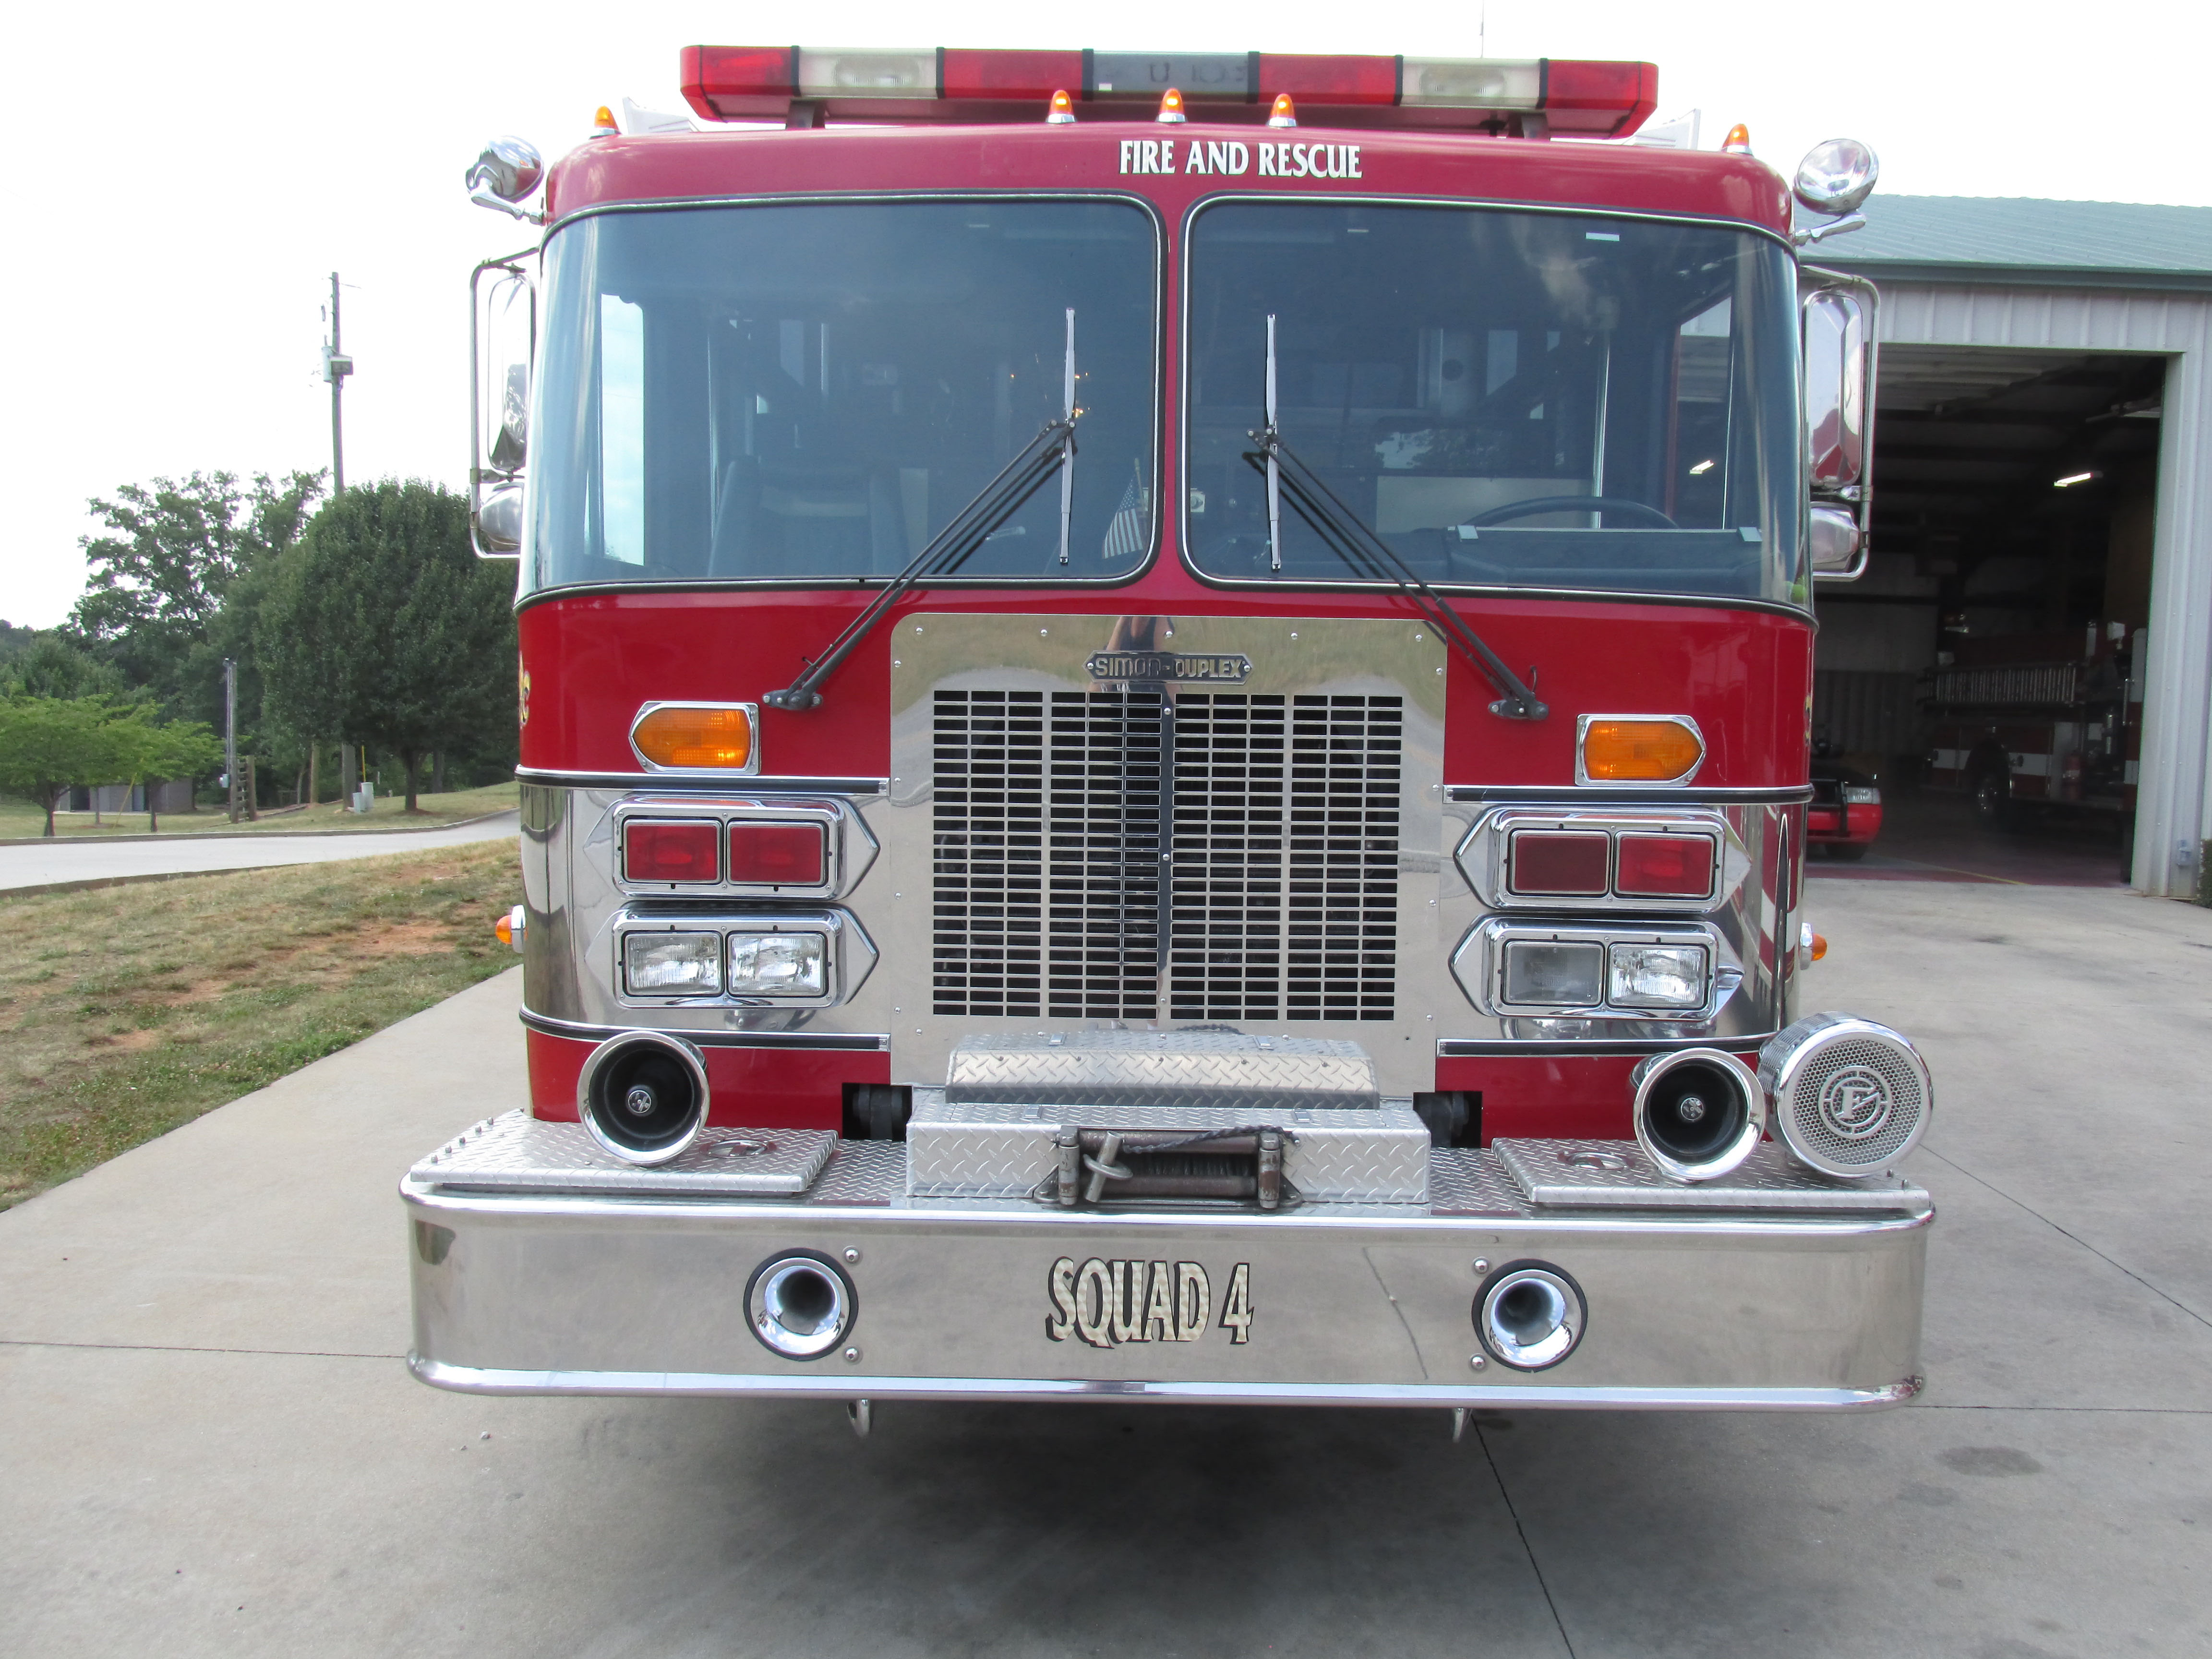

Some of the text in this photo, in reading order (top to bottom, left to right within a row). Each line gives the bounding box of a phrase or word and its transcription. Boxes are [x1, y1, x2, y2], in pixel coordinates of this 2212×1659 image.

[1119, 140, 1363, 179] FIRE AND RESCUE
[1045, 1256, 1255, 1349] SQUAD 4
